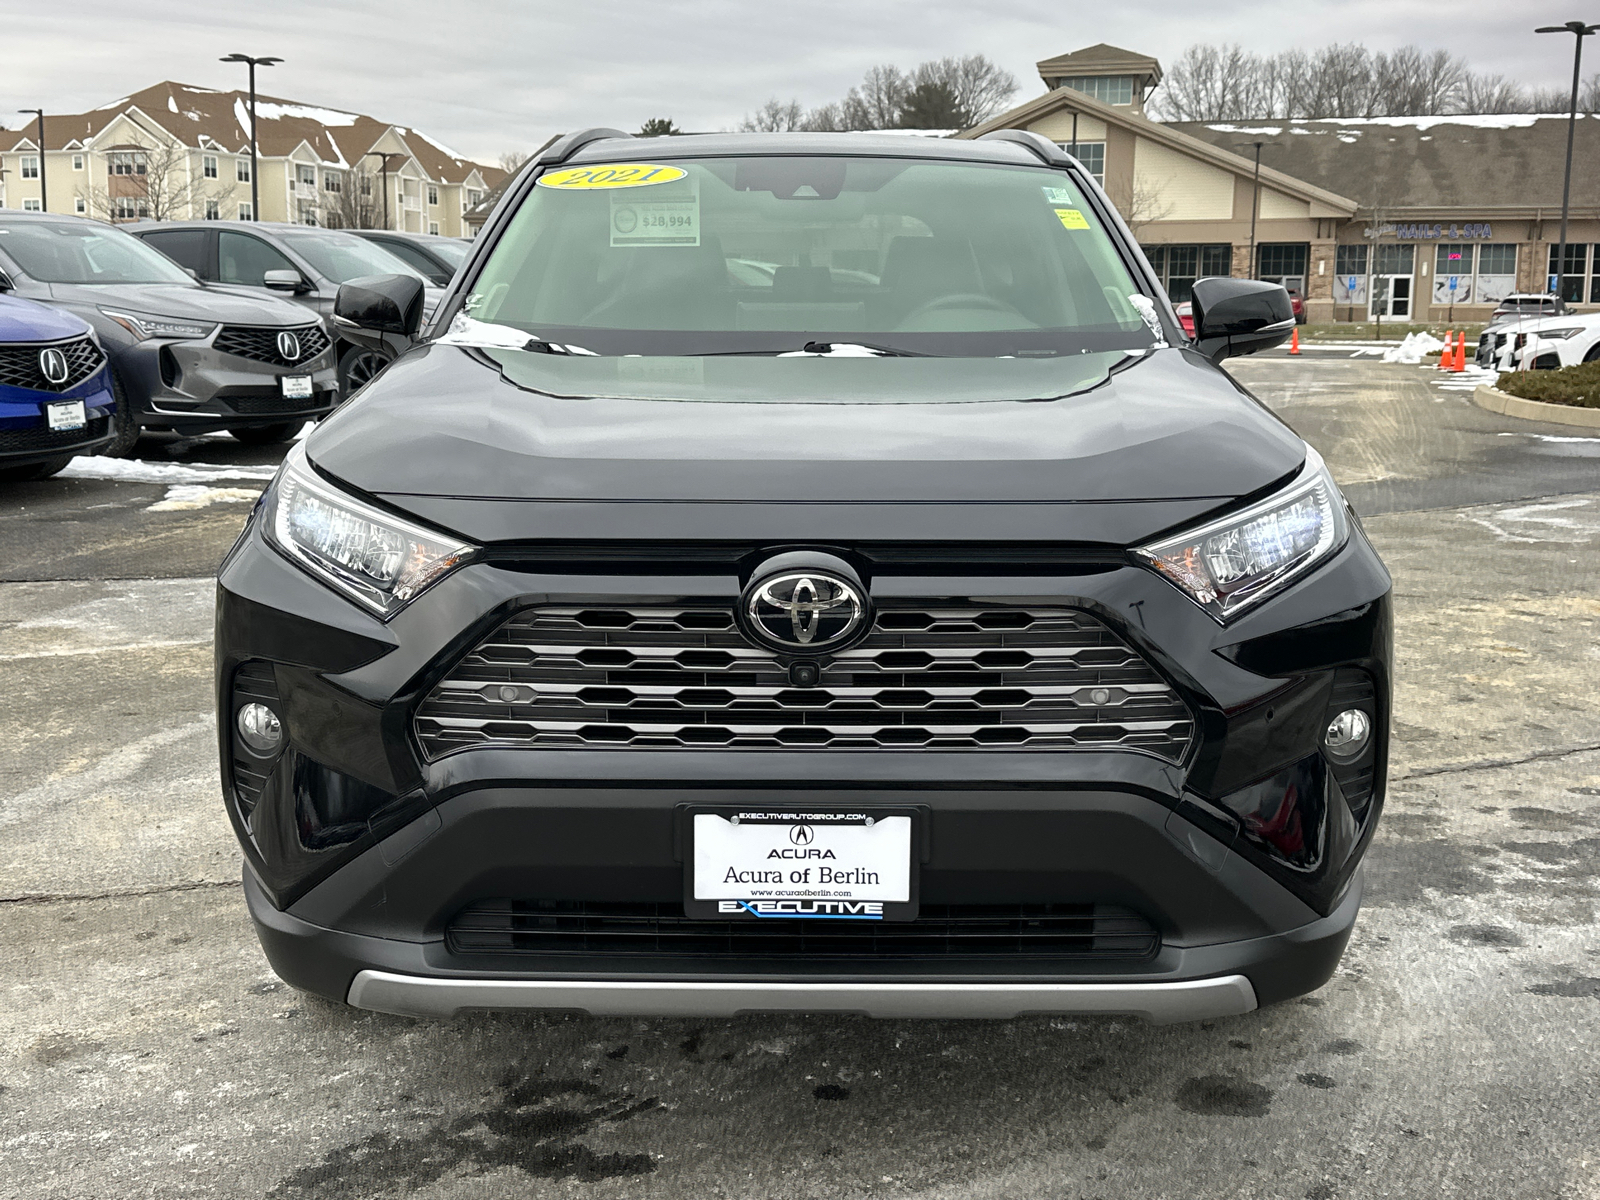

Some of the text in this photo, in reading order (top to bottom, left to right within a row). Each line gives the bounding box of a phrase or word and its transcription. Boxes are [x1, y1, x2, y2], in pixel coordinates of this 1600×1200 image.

[559, 168, 665, 185] 2021
[642, 215, 692, 228] $28,994
[1397, 223, 1442, 239] NAILS
[1449, 223, 1459, 238] &
[1463, 223, 1493, 238] SPA
[739, 812, 866, 820] EXECUTIVEAUTOGROUP.COM
[767, 849, 836, 860] ACURA
[723, 866, 880, 885] Acura of Berlin
[750, 889, 852, 897] www.acuraofberlin.com
[718, 900, 883, 914] EXECUTIVE
